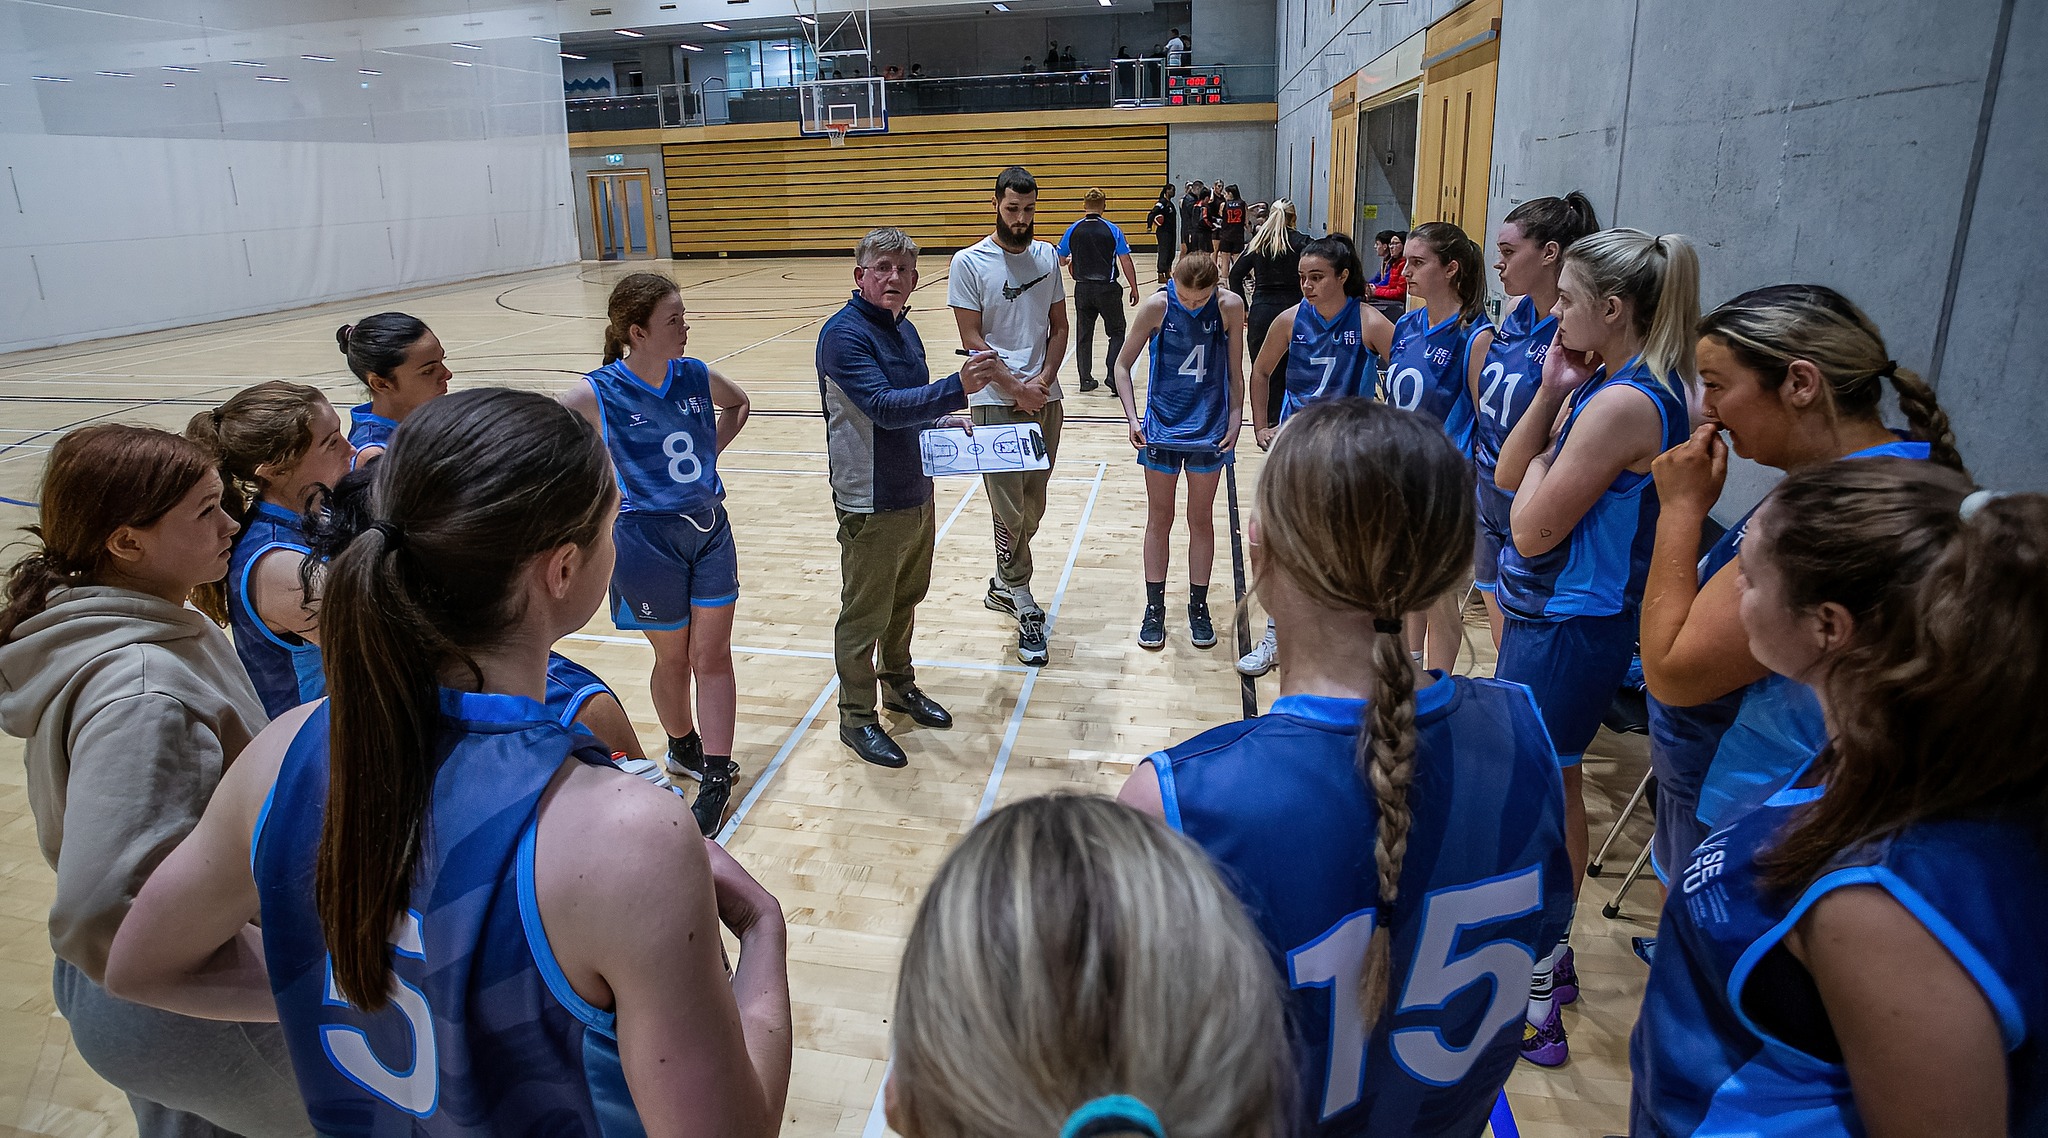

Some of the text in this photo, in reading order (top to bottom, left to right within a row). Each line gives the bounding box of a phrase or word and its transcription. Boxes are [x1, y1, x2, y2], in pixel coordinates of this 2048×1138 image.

[1227, 209, 1243, 224] 12
[1343, 330, 1355, 338] SE
[1343, 337, 1356, 345] TU
[1177, 344, 1208, 383] 4
[1432, 355, 1446, 365] TU
[1435, 347, 1450, 358] SE
[1309, 356, 1338, 397] 7
[1479, 361, 1524, 428] 21
[662, 431, 702, 484] 8
[641, 602, 650, 611] 8
[1683, 856, 1702, 894] TU
[1702, 849, 1726, 883] SE
[1286, 864, 1544, 1123] 15
[318, 907, 440, 1119] 5
